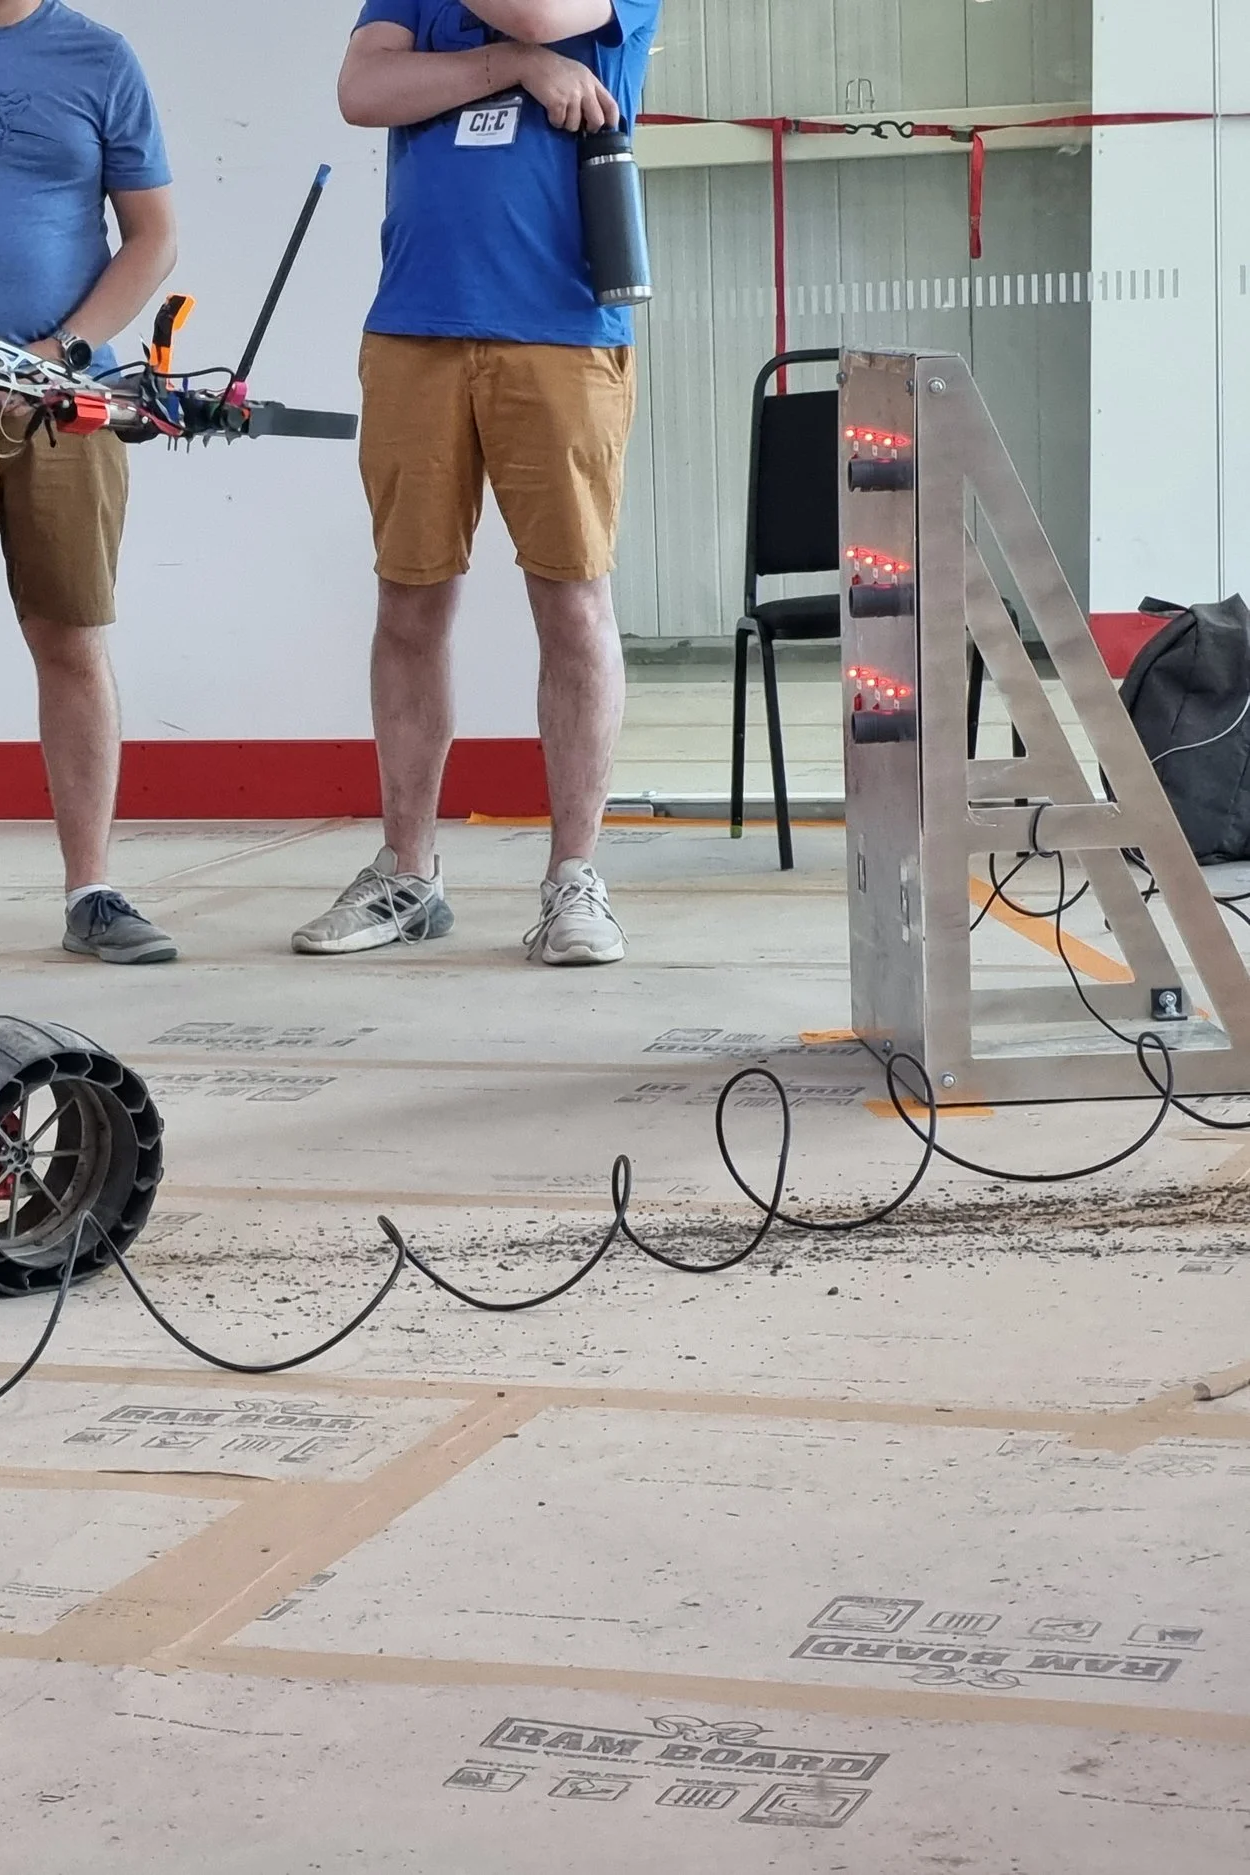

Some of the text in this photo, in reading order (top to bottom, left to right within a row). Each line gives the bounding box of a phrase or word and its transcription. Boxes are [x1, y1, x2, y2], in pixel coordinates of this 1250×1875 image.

[118, 1409, 364, 1430] RAM BOAR
[811, 1640, 1164, 1676] RAM BOARD
[506, 1725, 869, 1774] RAM BOARD
